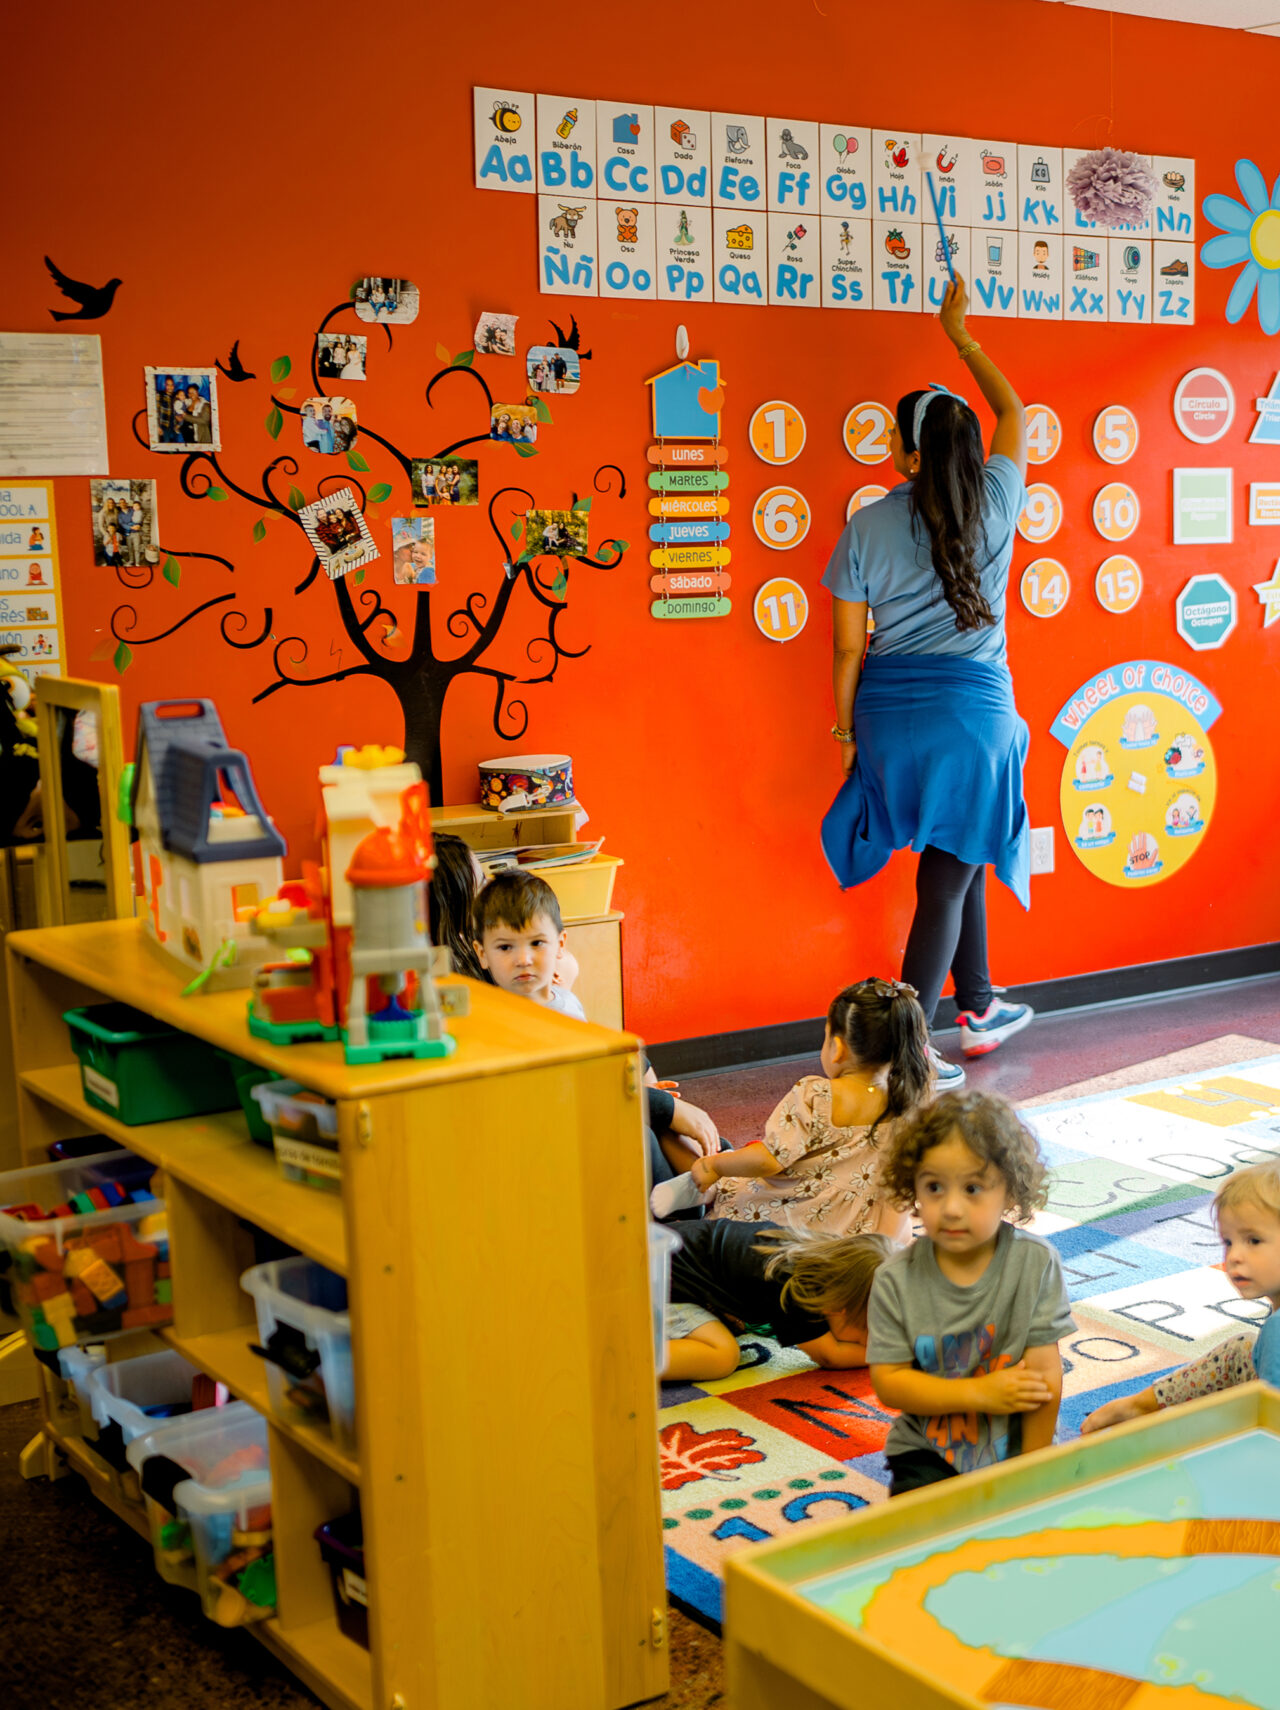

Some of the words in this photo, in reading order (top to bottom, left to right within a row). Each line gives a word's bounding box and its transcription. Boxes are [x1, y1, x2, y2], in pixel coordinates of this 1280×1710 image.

[494, 135, 517, 145] Abeja
[552, 141, 582, 151] Biberón
[617, 147, 636, 155] Casa
[480, 144, 533, 183] Aa
[541, 150, 594, 189] Bb
[674, 152, 693, 160] Dado
[725, 156, 754, 165] Elefante
[836, 167, 856, 175] Globo
[604, 156, 649, 193] Cc
[660, 164, 707, 198] Dd
[719, 165, 760, 202] Ee
[777, 171, 811, 206] Ff
[890, 172, 904, 180] Hoja
[826, 174, 867, 211] Gg
[878, 185, 916, 215] Hh
[982, 191, 1006, 222] Jj
[1023, 197, 1059, 225] Kk
[1156, 205, 1191, 234] Nn
[563, 239, 574, 249] Ñu
[620, 245, 635, 253] Oso
[669, 248, 700, 257] Princesa
[729, 252, 751, 260] Queso
[786, 255, 803, 263] Rosa
[544, 246, 594, 289] Ññ
[674, 256, 695, 264] Verde
[886, 262, 910, 270] Tomate
[605, 261, 651, 291] Oo
[666, 264, 704, 299] Pp
[719, 264, 762, 299] Qq
[776, 263, 814, 300] Rr
[831, 273, 863, 301] Ss
[881, 270, 915, 305] Tt
[928, 276, 949, 306] U
[975, 276, 1014, 310] Vv
[1022, 289, 1060, 314] Ww
[1069, 285, 1104, 314] Xx
[1116, 289, 1145, 320] Yy
[1158, 290, 1191, 318] Zz
[1188, 399, 1221, 409] Círculo
[1193, 412, 1216, 420] Circle
[764, 409, 786, 458] 1
[855, 408, 887, 456] 2
[1026, 412, 1052, 457] 4
[1103, 414, 1129, 458] 5
[763, 494, 799, 543] 6
[1025, 492, 1054, 536] 9
[1100, 498, 1134, 529] 10
[1027, 574, 1064, 605] 14
[1101, 569, 1136, 603] 15
[763, 592, 798, 631] 11
[1185, 605, 1227, 618] Octágono
[1191, 617, 1223, 627] Octagon
[1129, 851, 1150, 865] STOP
